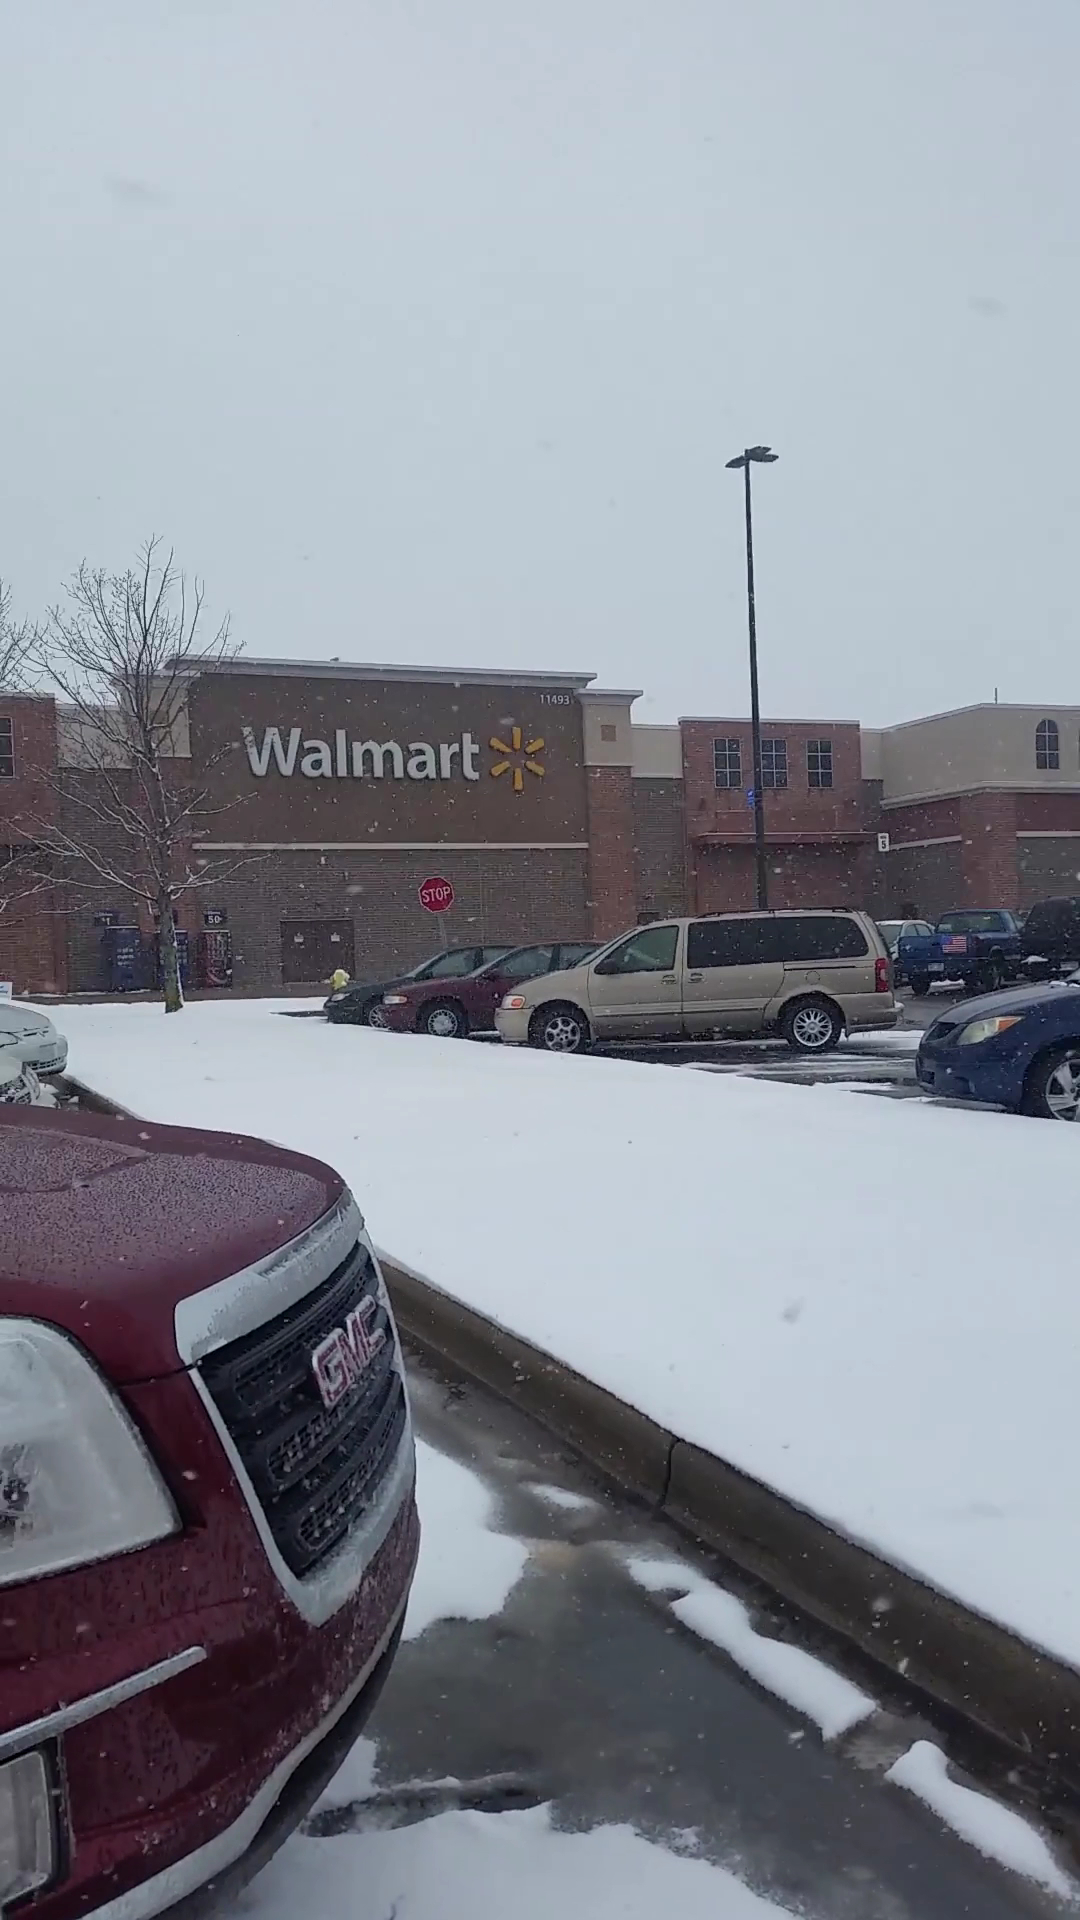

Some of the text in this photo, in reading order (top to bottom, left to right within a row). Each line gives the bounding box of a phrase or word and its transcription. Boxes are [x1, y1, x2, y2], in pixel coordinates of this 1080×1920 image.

[540, 694, 570, 705] 11493
[241, 726, 480, 780] Walmart
[881, 840, 887, 849] 5
[421, 886, 451, 903] STOP
[312, 1294, 387, 1409] GMC
